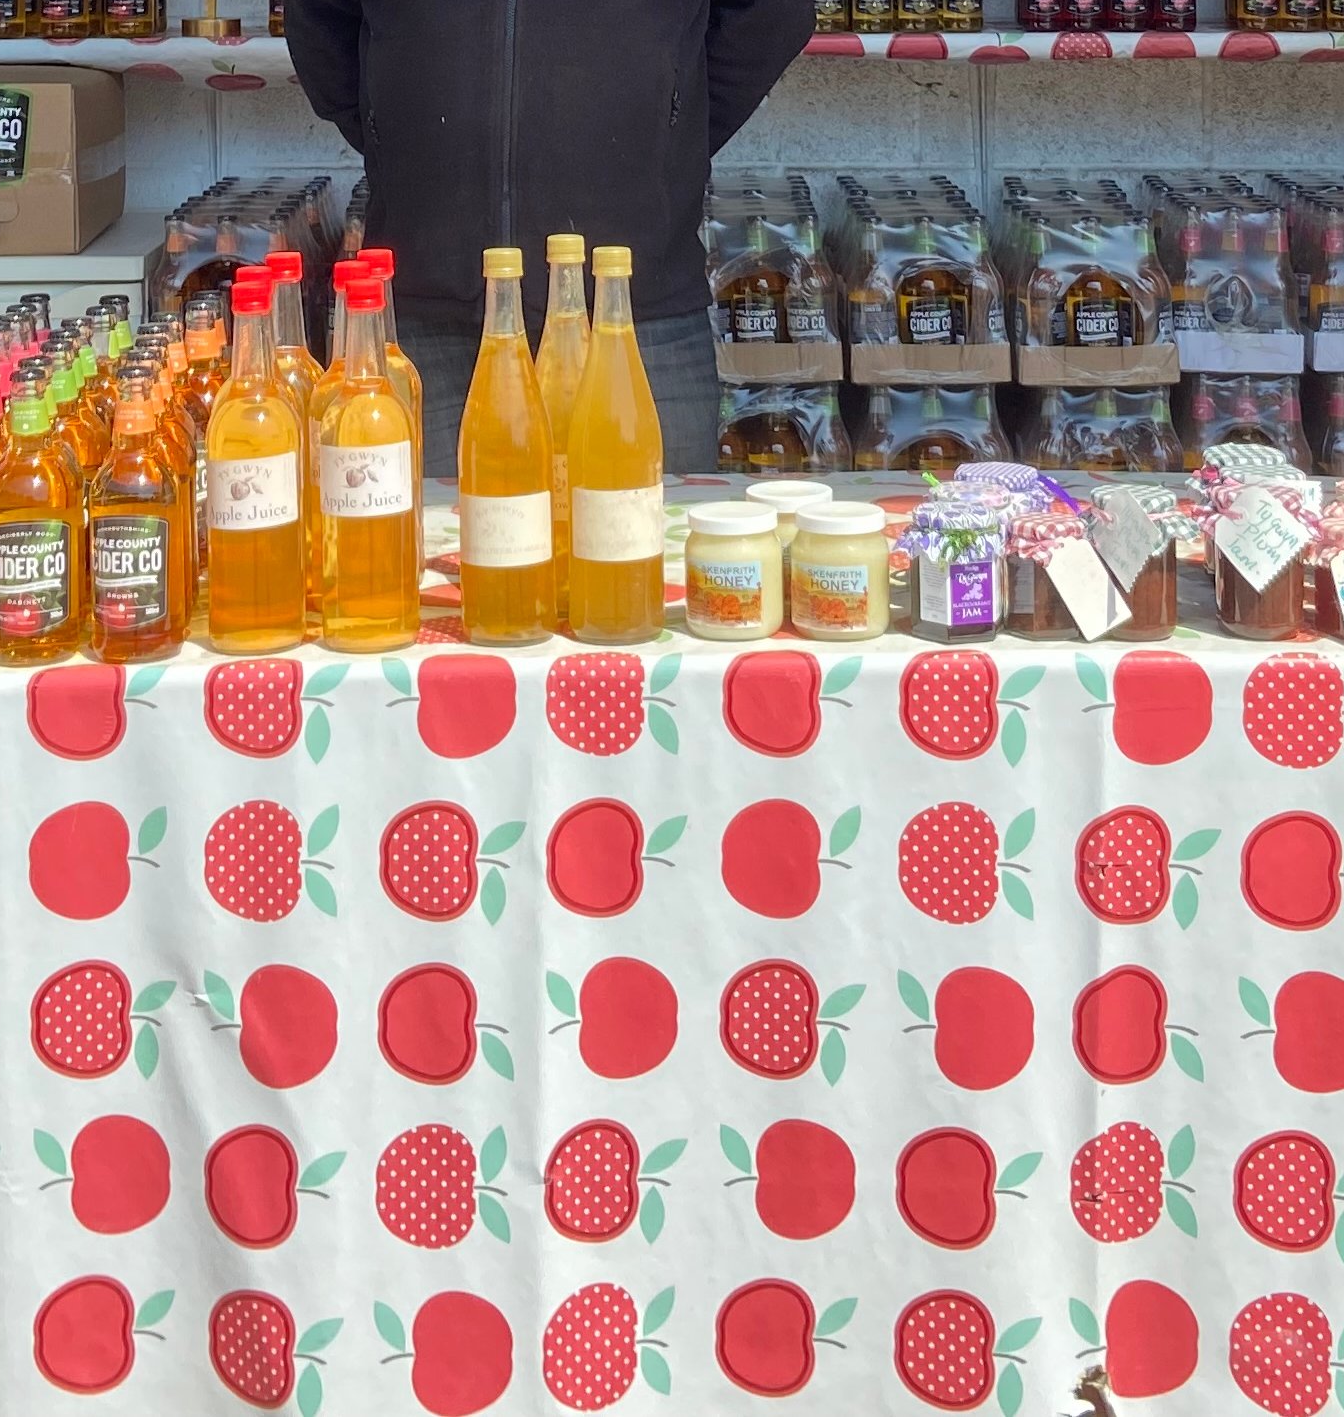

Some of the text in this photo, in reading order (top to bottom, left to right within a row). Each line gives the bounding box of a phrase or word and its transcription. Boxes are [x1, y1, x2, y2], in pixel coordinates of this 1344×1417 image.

[362, 491, 403, 507] Juice
[248, 504, 288, 520] Juice
[21, 540, 64, 554] COUNTY
[43, 556, 65, 576] CO
[701, 565, 756, 574] SKENFRITH
[807, 568, 862, 578] SKENFRITH
[705, 575, 753, 588] HONEY
[810, 579, 859, 591] HONEY
[961, 608, 982, 620] JAM
